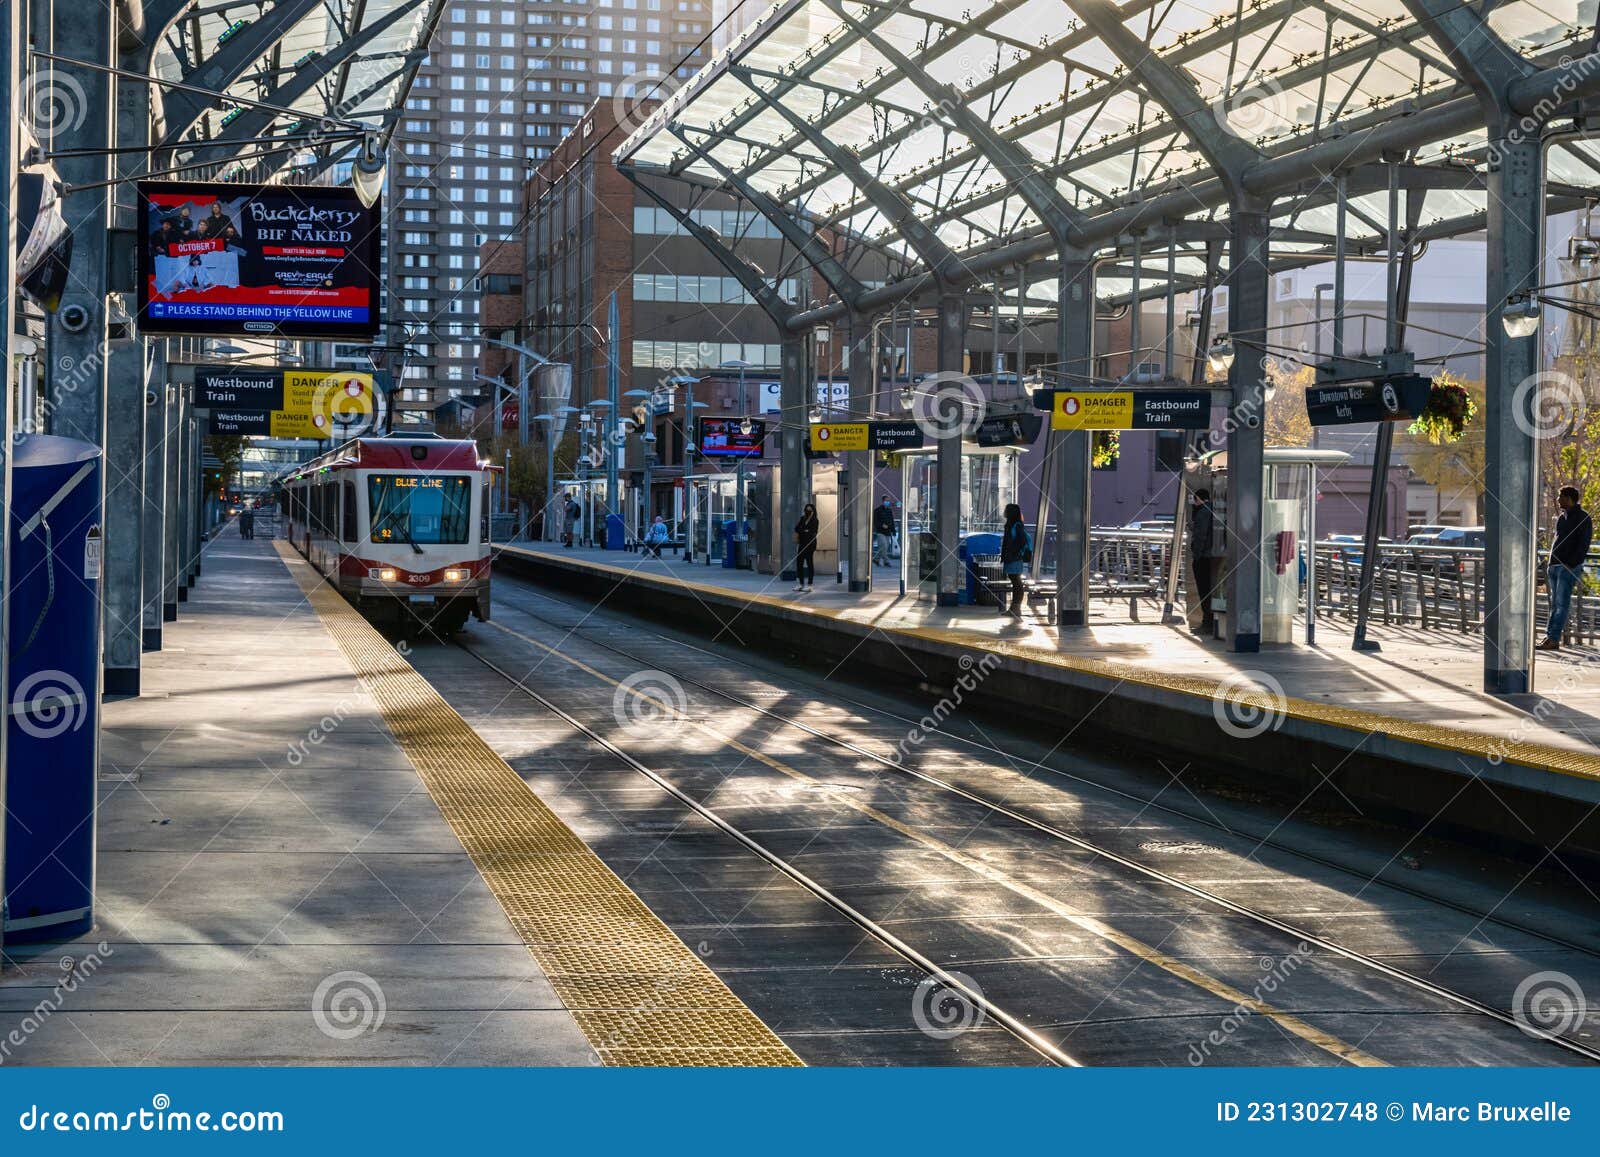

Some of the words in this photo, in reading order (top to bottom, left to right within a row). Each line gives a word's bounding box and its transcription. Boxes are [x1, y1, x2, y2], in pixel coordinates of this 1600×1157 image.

[249, 202, 360, 229] Buckcherry
[257, 228, 287, 241] BIF
[291, 229, 352, 242] NAKED
[178, 242, 210, 253] OCTOBER
[211, 241, 216, 250] 7
[305, 272, 334, 280] EAGLE
[168, 305, 202, 315] PLEASE
[203, 306, 235, 316] STAND
[236, 307, 272, 316] BEHIND
[273, 308, 291, 317] THE
[292, 308, 331, 318] YELLOW
[332, 309, 353, 319] LINE
[206, 377, 274, 389] Westbound
[292, 377, 339, 387] DANGER
[206, 390, 236, 402] Train
[1319, 390, 1349, 403] Downtown
[1084, 398, 1126, 407] DANGER
[1144, 400, 1200, 411] Eastbound
[217, 413, 264, 422] Westbound
[1144, 412, 1171, 422] Train
[217, 422, 238, 430] Train
[876, 428, 916, 436] Eastbound
[395, 478, 418, 487] BLUE
[421, 479, 443, 488] LINE
